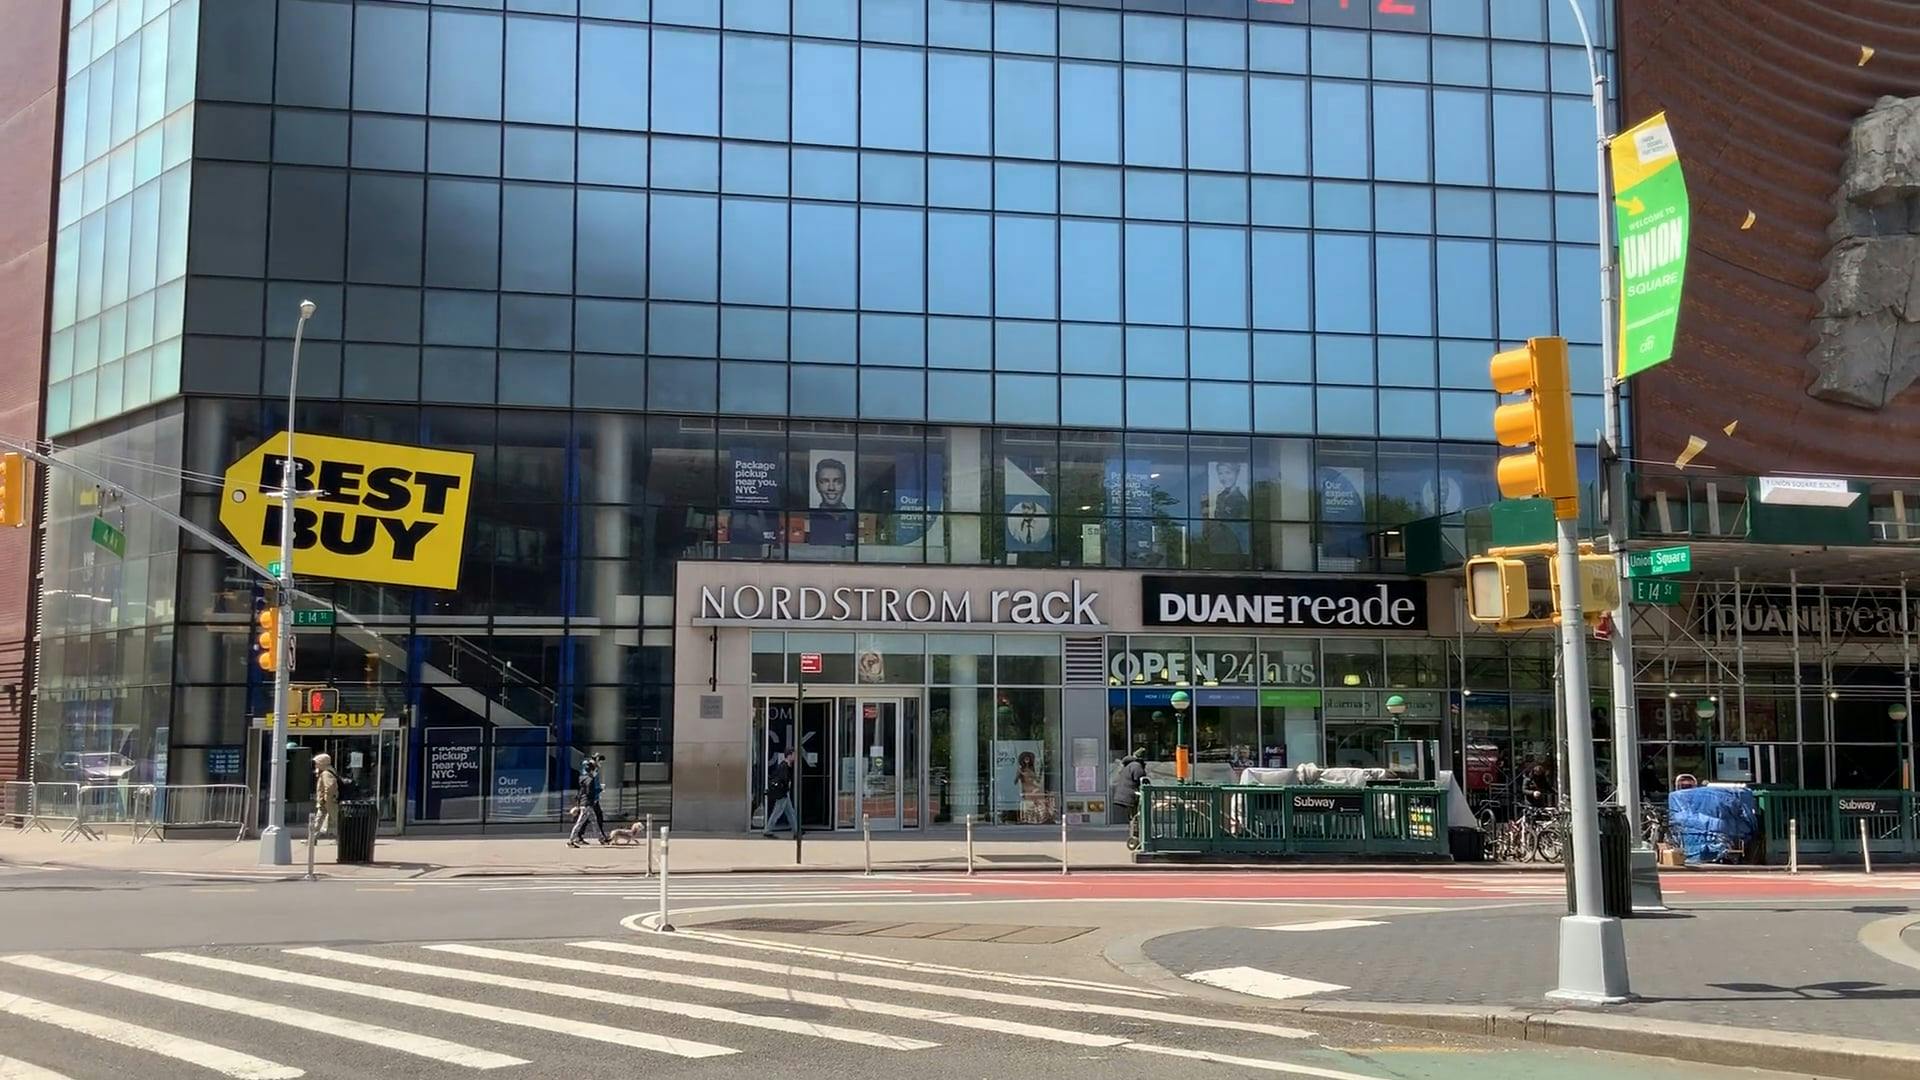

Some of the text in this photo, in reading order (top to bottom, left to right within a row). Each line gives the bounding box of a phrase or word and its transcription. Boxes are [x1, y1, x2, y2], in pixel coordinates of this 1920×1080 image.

[1628, 206, 1676, 232] WELCOME TO
[1623, 216, 1682, 280] UNION
[1627, 272, 1679, 297] SQUARE
[735, 460, 776, 471] Package
[735, 469, 768, 480] pickup
[259, 453, 461, 515] BEST
[900, 495, 919, 504] Our
[260, 504, 439, 562] BUY
[1630, 551, 1687, 568] Union Square
[1638, 582, 1645, 600] E
[1648, 583, 1660, 600] 14
[700, 578, 1101, 625] NORDSTROM rack
[1159, 583, 1416, 626] DUANE reade
[298, 612, 304, 624] E
[308, 612, 317, 624] 14
[1110, 651, 1217, 683] OPEN
[332, 712, 385, 728] BUY
[431, 751, 468, 762] pickup
[431, 761, 478, 771] near you,
[431, 769, 458, 779] NYC.
[498, 776, 519, 785] Our
[497, 786, 533, 796] expert
[1293, 795, 1336, 809] Subway
[1838, 799, 1877, 812] Subway
